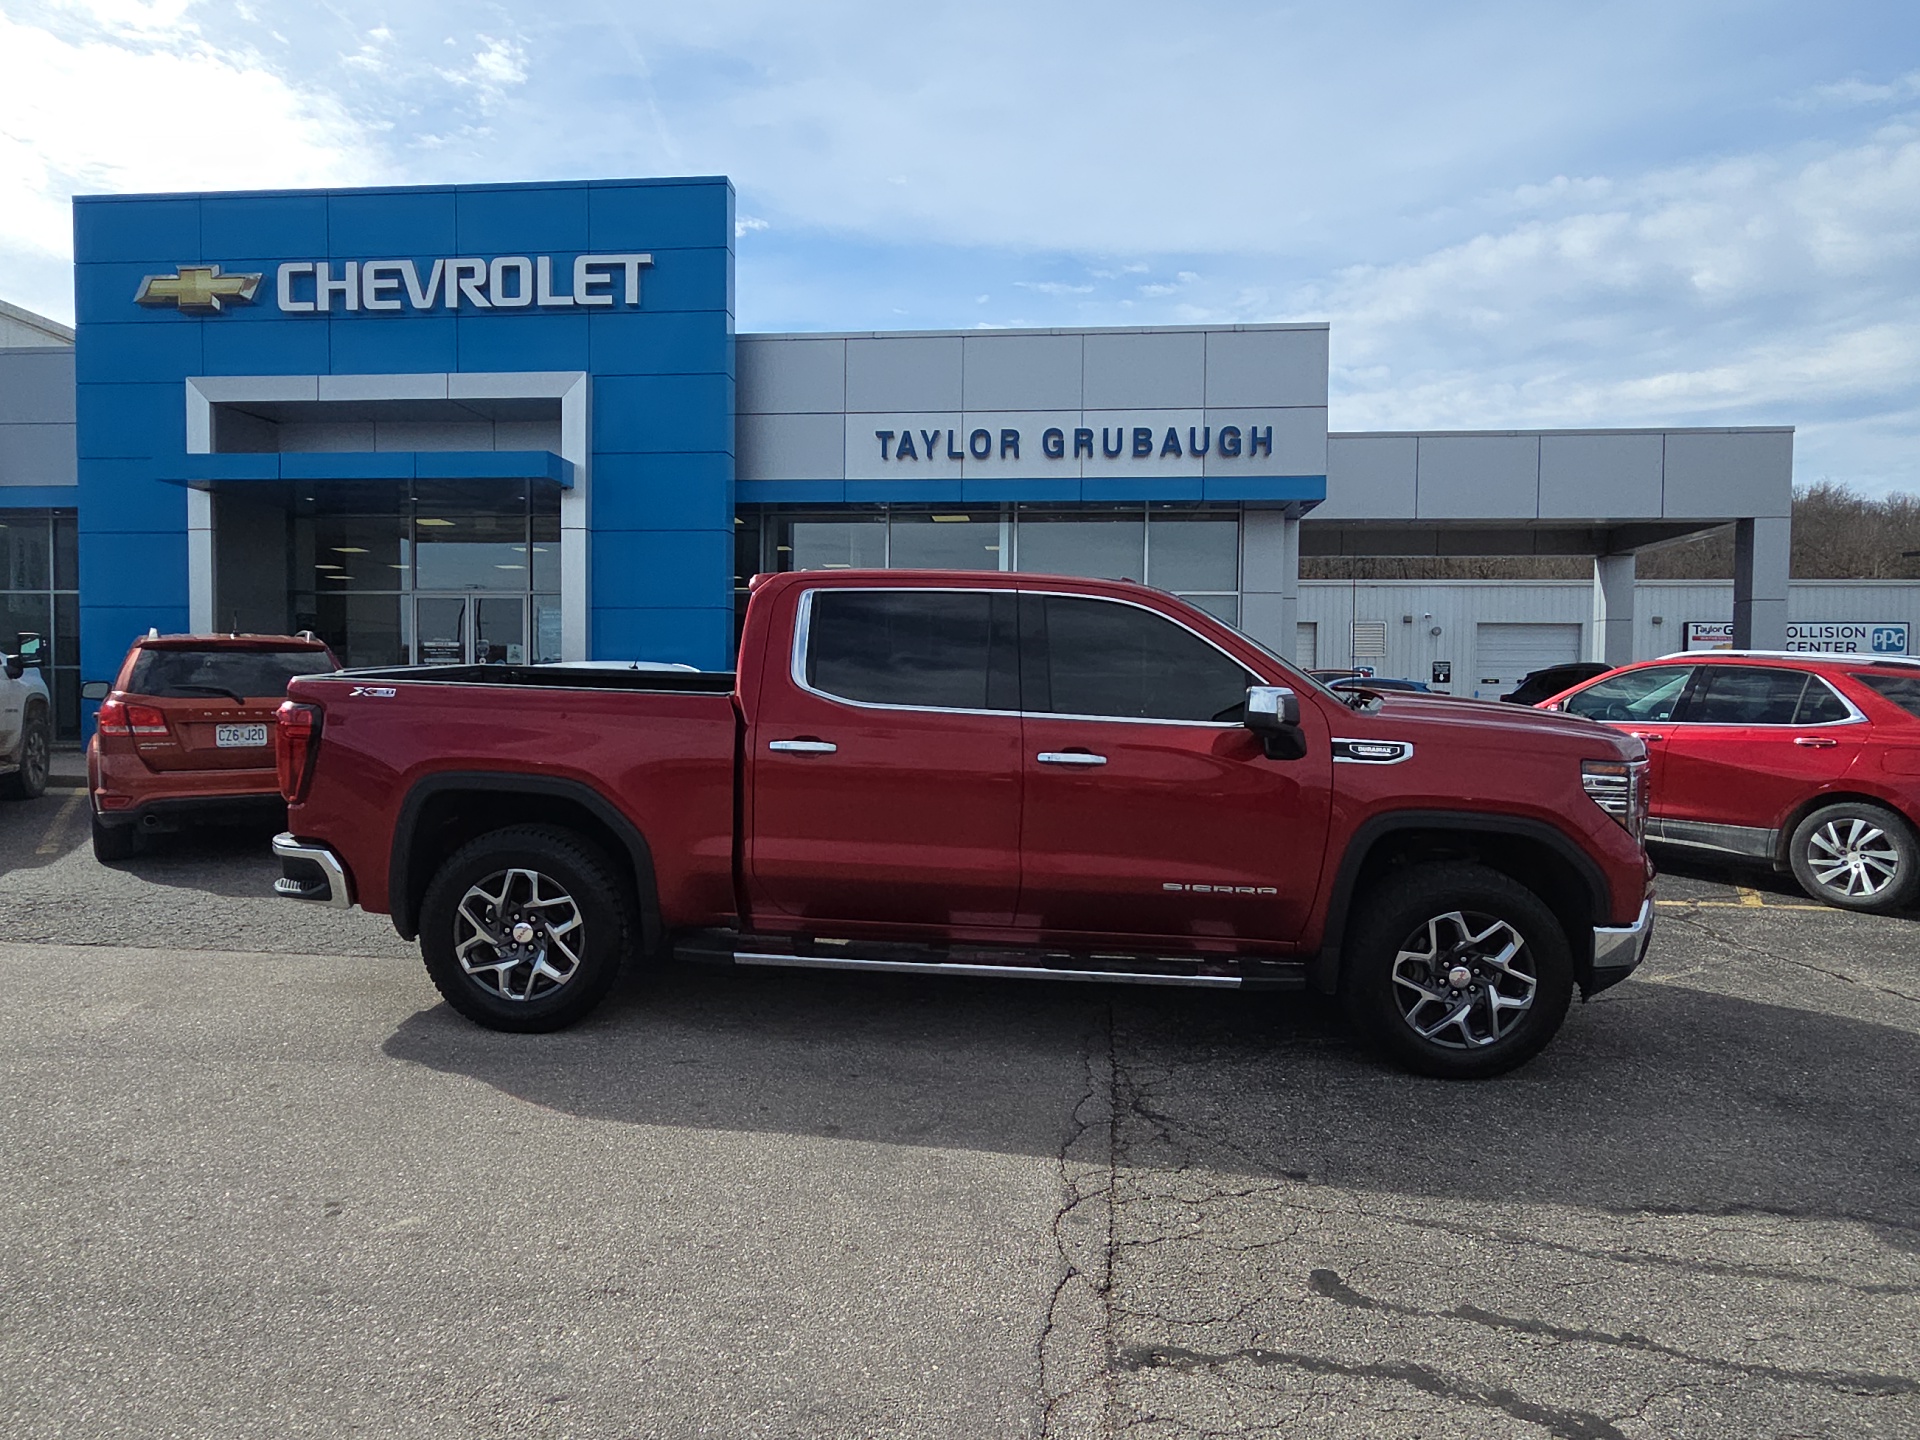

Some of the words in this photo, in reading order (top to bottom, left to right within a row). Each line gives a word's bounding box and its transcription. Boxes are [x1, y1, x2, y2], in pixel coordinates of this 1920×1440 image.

[277, 252, 653, 312] CHEVROLET
[875, 428, 1021, 460] TAYLOR
[1042, 425, 1273, 458] GRUBAUGH
[1692, 624, 1723, 635] Taylor
[1786, 626, 1866, 638] OLLISION
[1873, 629, 1904, 650] PPG
[1786, 641, 1857, 653] CENTER
[218, 729, 240, 742] CZ6
[1162, 882, 1278, 895] SIERRA
